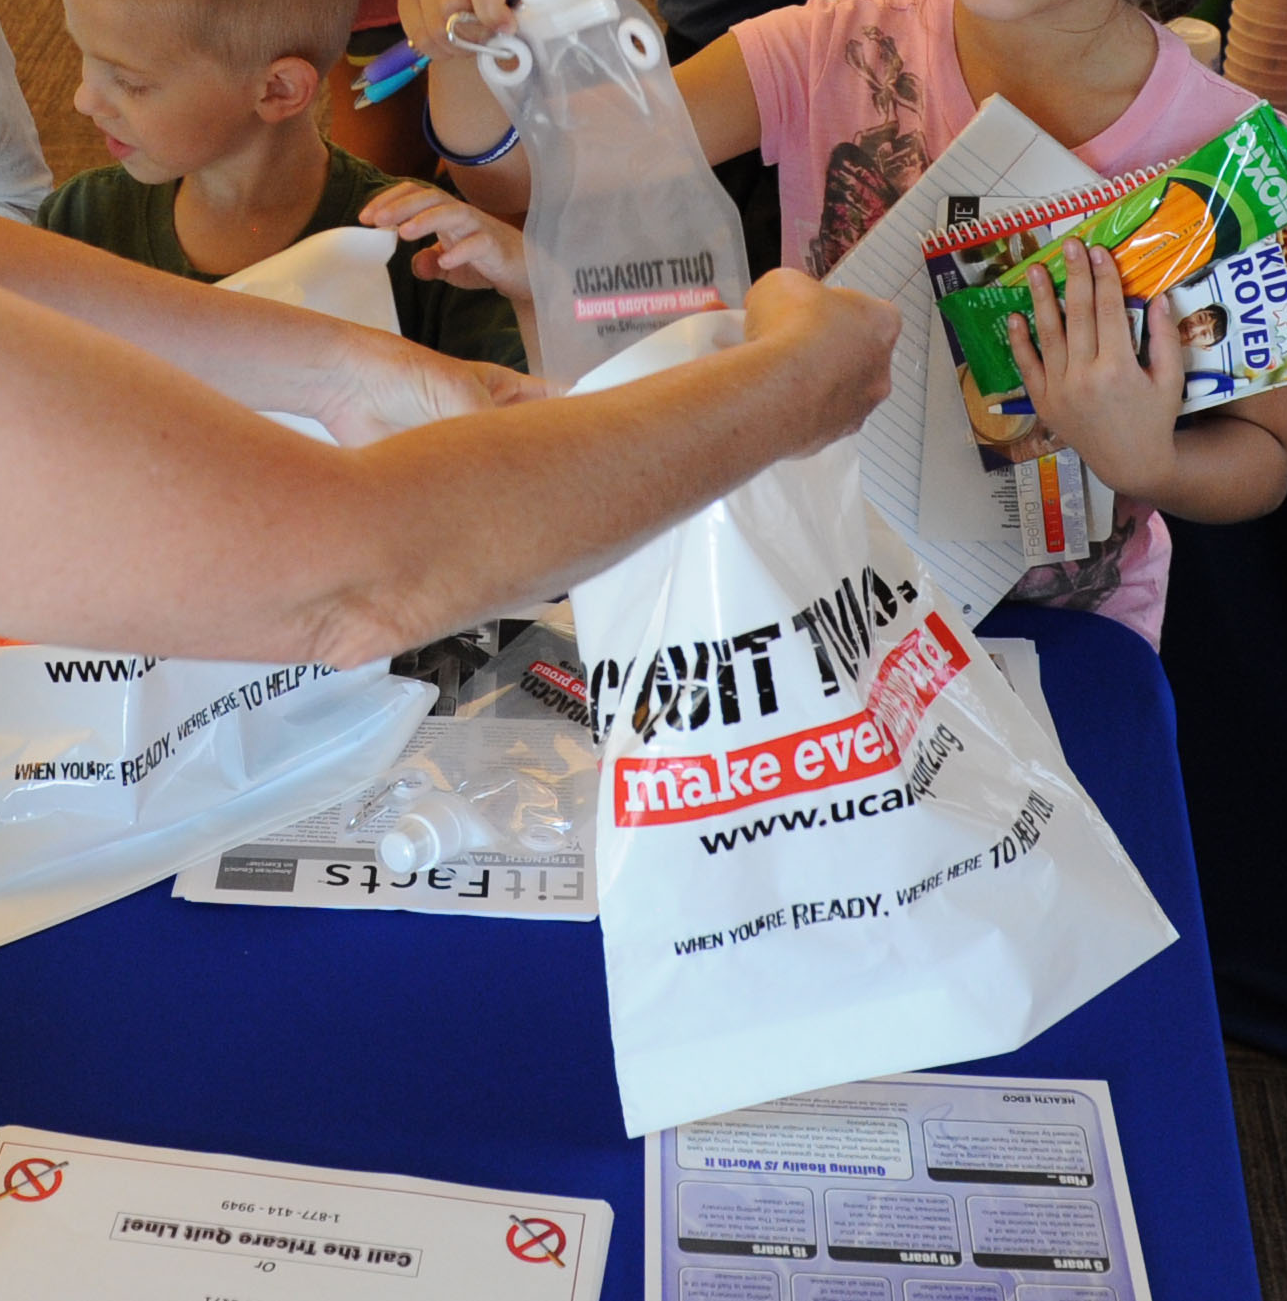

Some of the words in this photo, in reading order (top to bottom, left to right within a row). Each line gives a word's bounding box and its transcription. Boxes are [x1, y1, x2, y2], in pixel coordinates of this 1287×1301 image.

[1228, 257, 1272, 372] ROVED
[1023, 497, 1041, 558] Feeling
[531, 663, 571, 688] proud
[15, 761, 55, 780] WHEN
[210, 692, 240, 719] HERE
[238, 680, 263, 712] TO
[264, 665, 308, 701] HELP
[623, 749, 781, 813] make
[505, 854, 577, 865] STRENGTH
[674, 931, 724, 956] WHEN
[947, 854, 982, 883] HERE
[989, 836, 1016, 869] TO
[1013, 809, 1041, 854] HELP
[1002, 1094, 1031, 1104] EDCO
[1034, 1095, 1076, 1105] HEALTH
[704, 1157, 715, 1168] It
[718, 1158, 762, 1170] Worth
[763, 1160, 779, 1172] IS
[782, 1160, 827, 1174] Really
[829, 1163, 887, 1177] Quitting
[1058, 1174, 1088, 1187] Plus
[220, 1199, 255, 1214] 9949
[267, 1205, 294, 1218] 414
[120, 1218, 180, 1239] Line!
[184, 1226, 233, 1245] Quit
[238, 1232, 317, 1256] Tricare
[752, 1244, 791, 1257] years
[323, 1242, 362, 1262] the
[367, 1246, 413, 1269] Call
[792, 1246, 808, 1259] 15
[899, 1251, 937, 1264] years
[939, 1252, 956, 1265] 10
[255, 1260, 277, 1273] Or
[1053, 1257, 1092, 1271] years
[1092, 1259, 1104, 1271] 5
